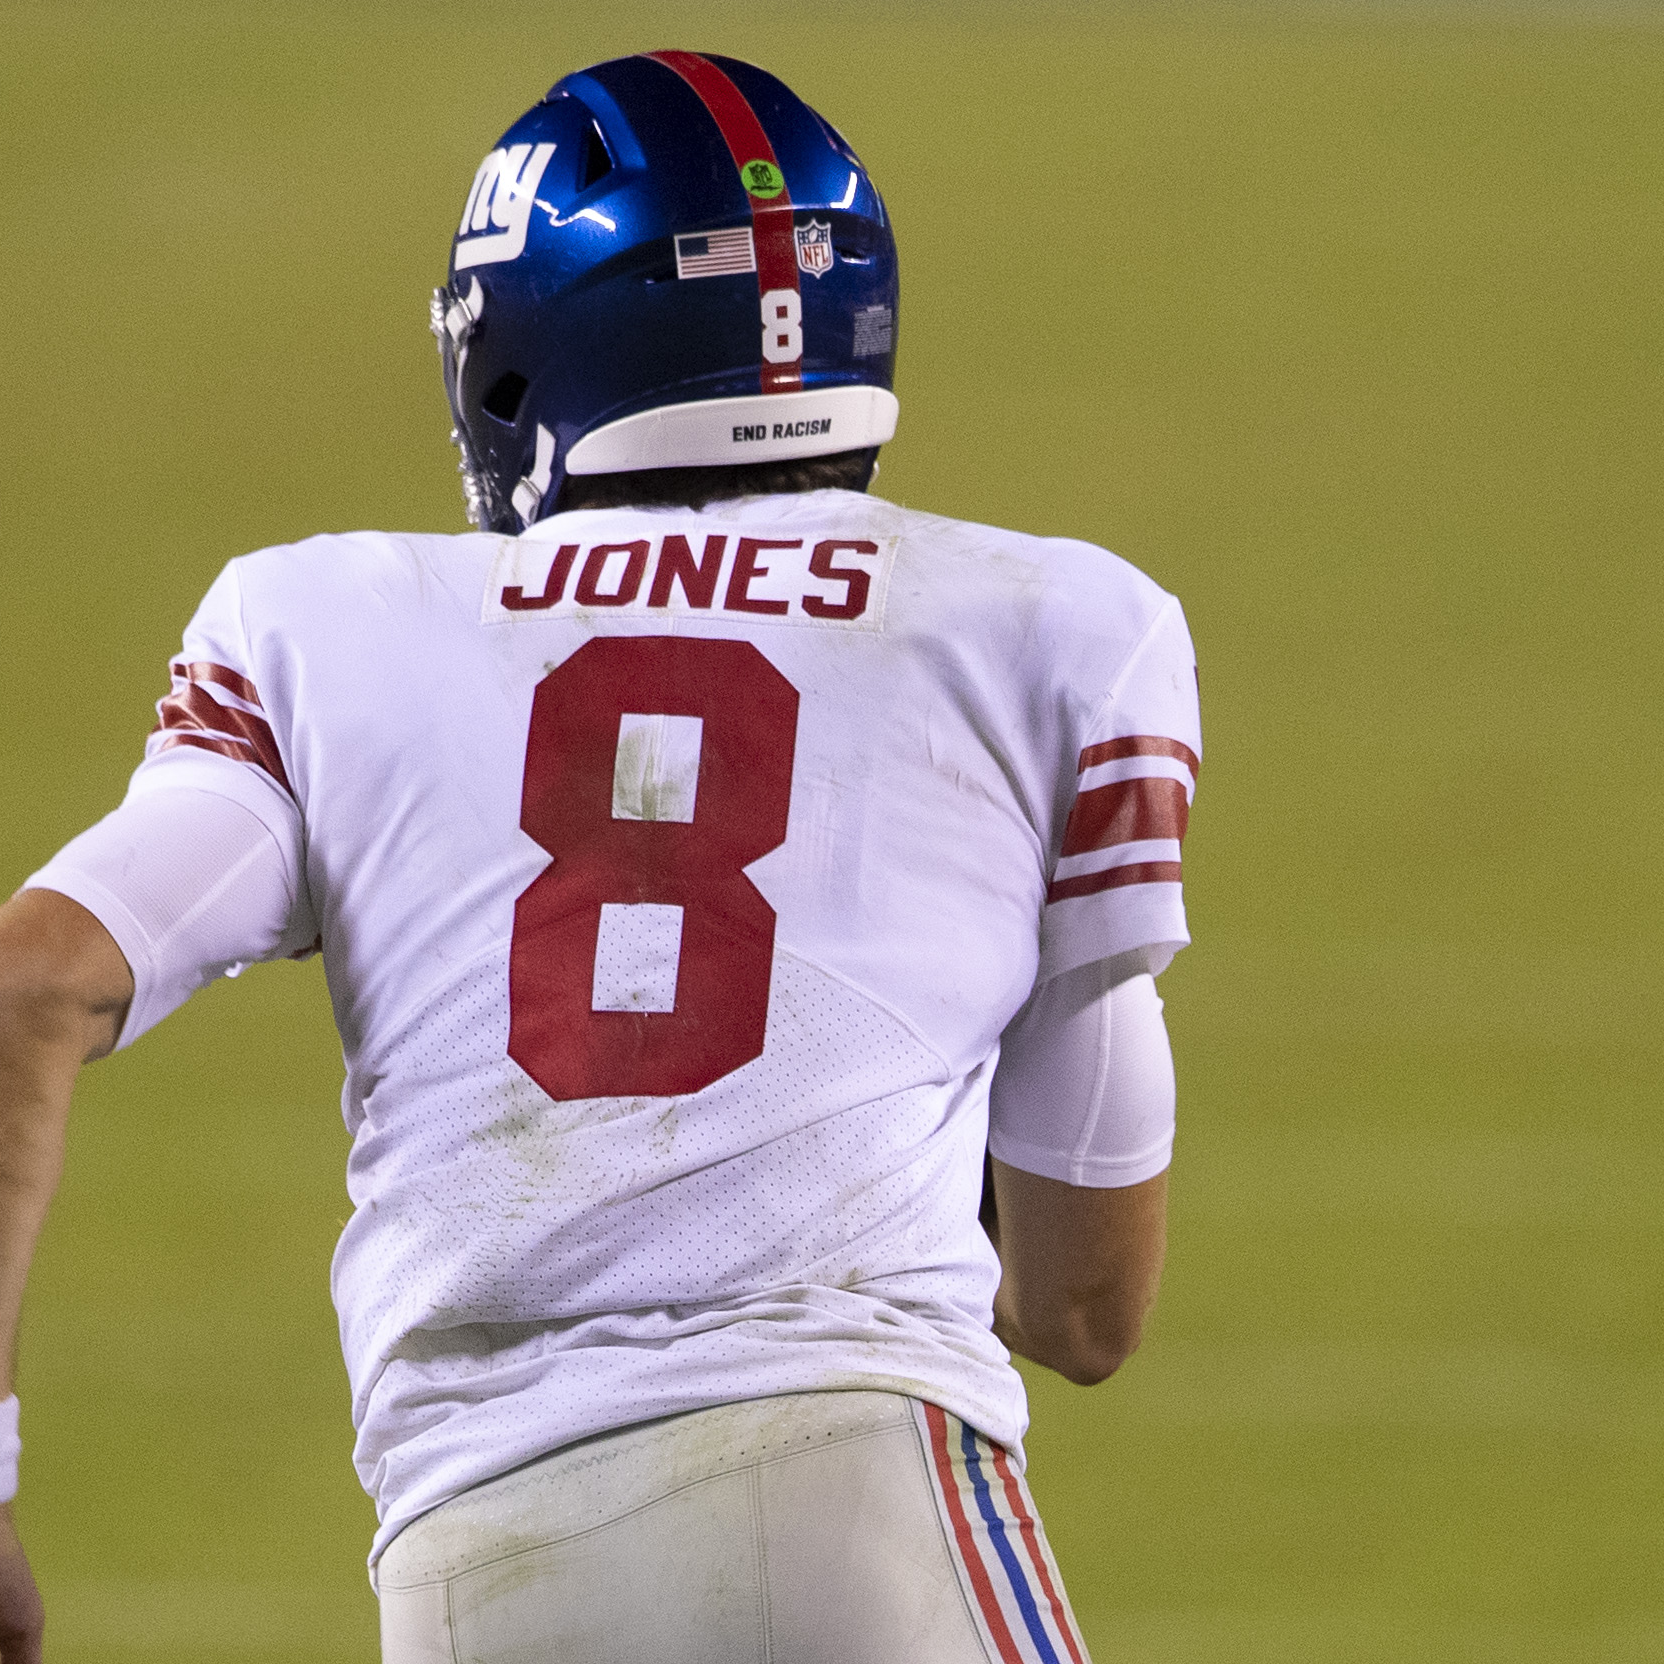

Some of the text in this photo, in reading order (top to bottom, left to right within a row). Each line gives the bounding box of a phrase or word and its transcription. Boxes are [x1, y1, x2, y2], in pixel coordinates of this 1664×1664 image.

[802, 244, 829, 268] NFL
[760, 288, 804, 364] 8
[732, 418, 832, 442] END RACISM
[500, 534, 879, 620] JONES
[506, 635, 800, 1101] 8
